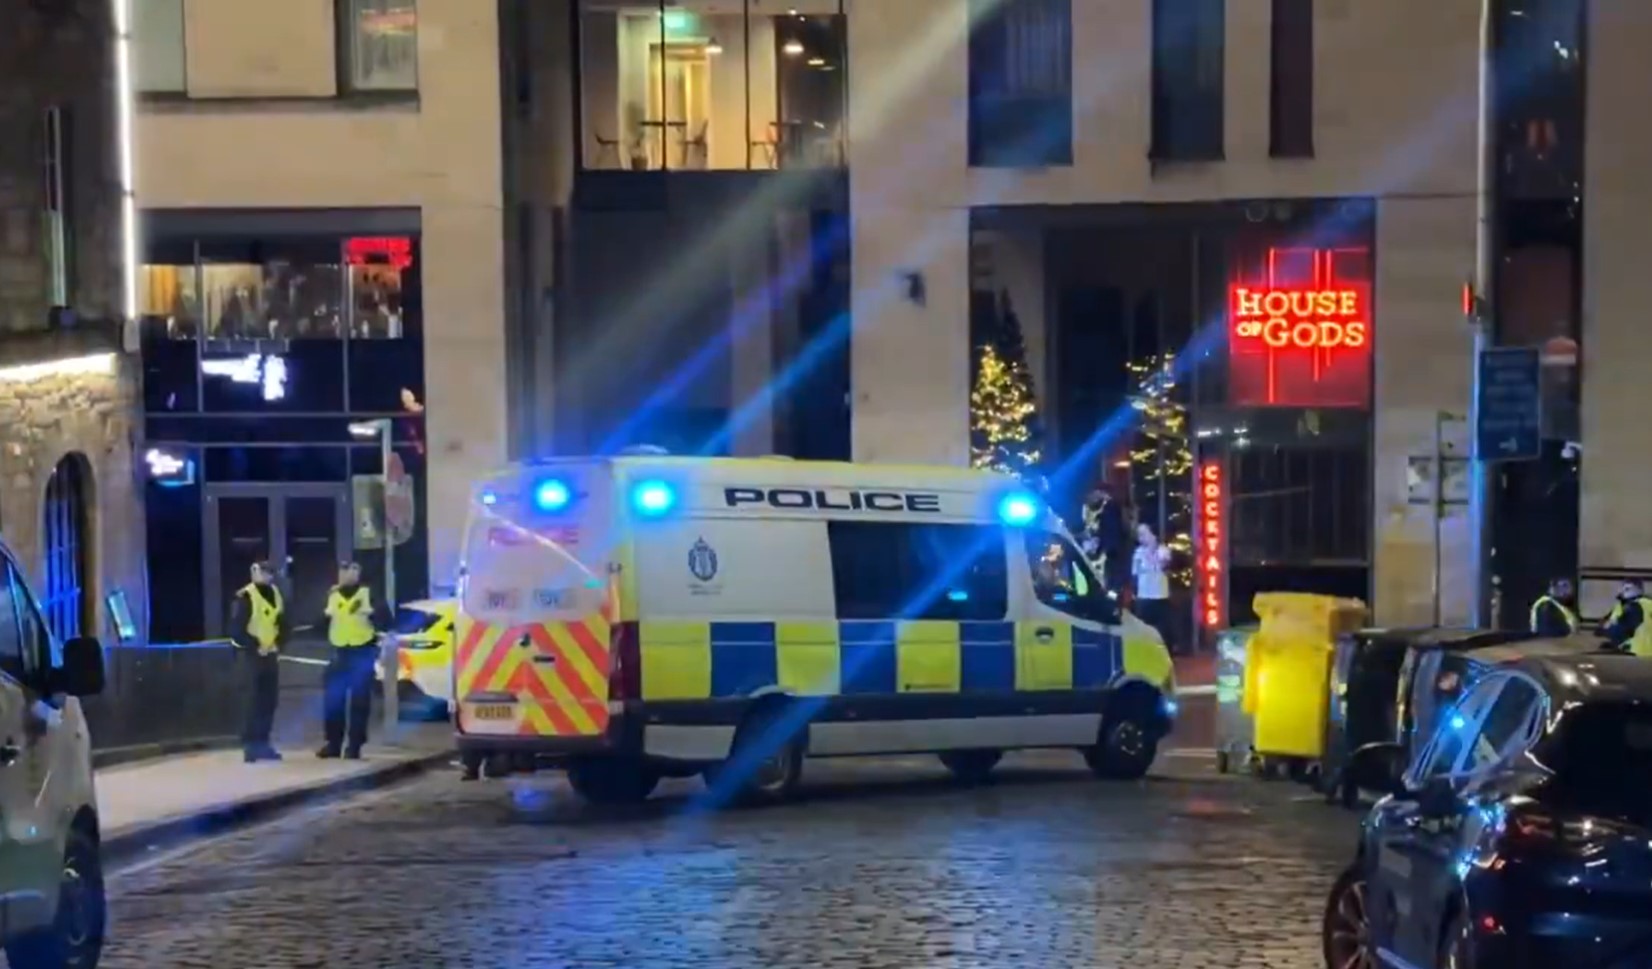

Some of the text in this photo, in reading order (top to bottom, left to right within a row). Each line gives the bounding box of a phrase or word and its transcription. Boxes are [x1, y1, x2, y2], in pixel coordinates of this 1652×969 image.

[1237, 289, 1357, 316] HOUSE
[1263, 318, 1366, 347] GODS
[724, 488, 941, 512] POLICE
[1204, 465, 1220, 625] COCKTAILS
